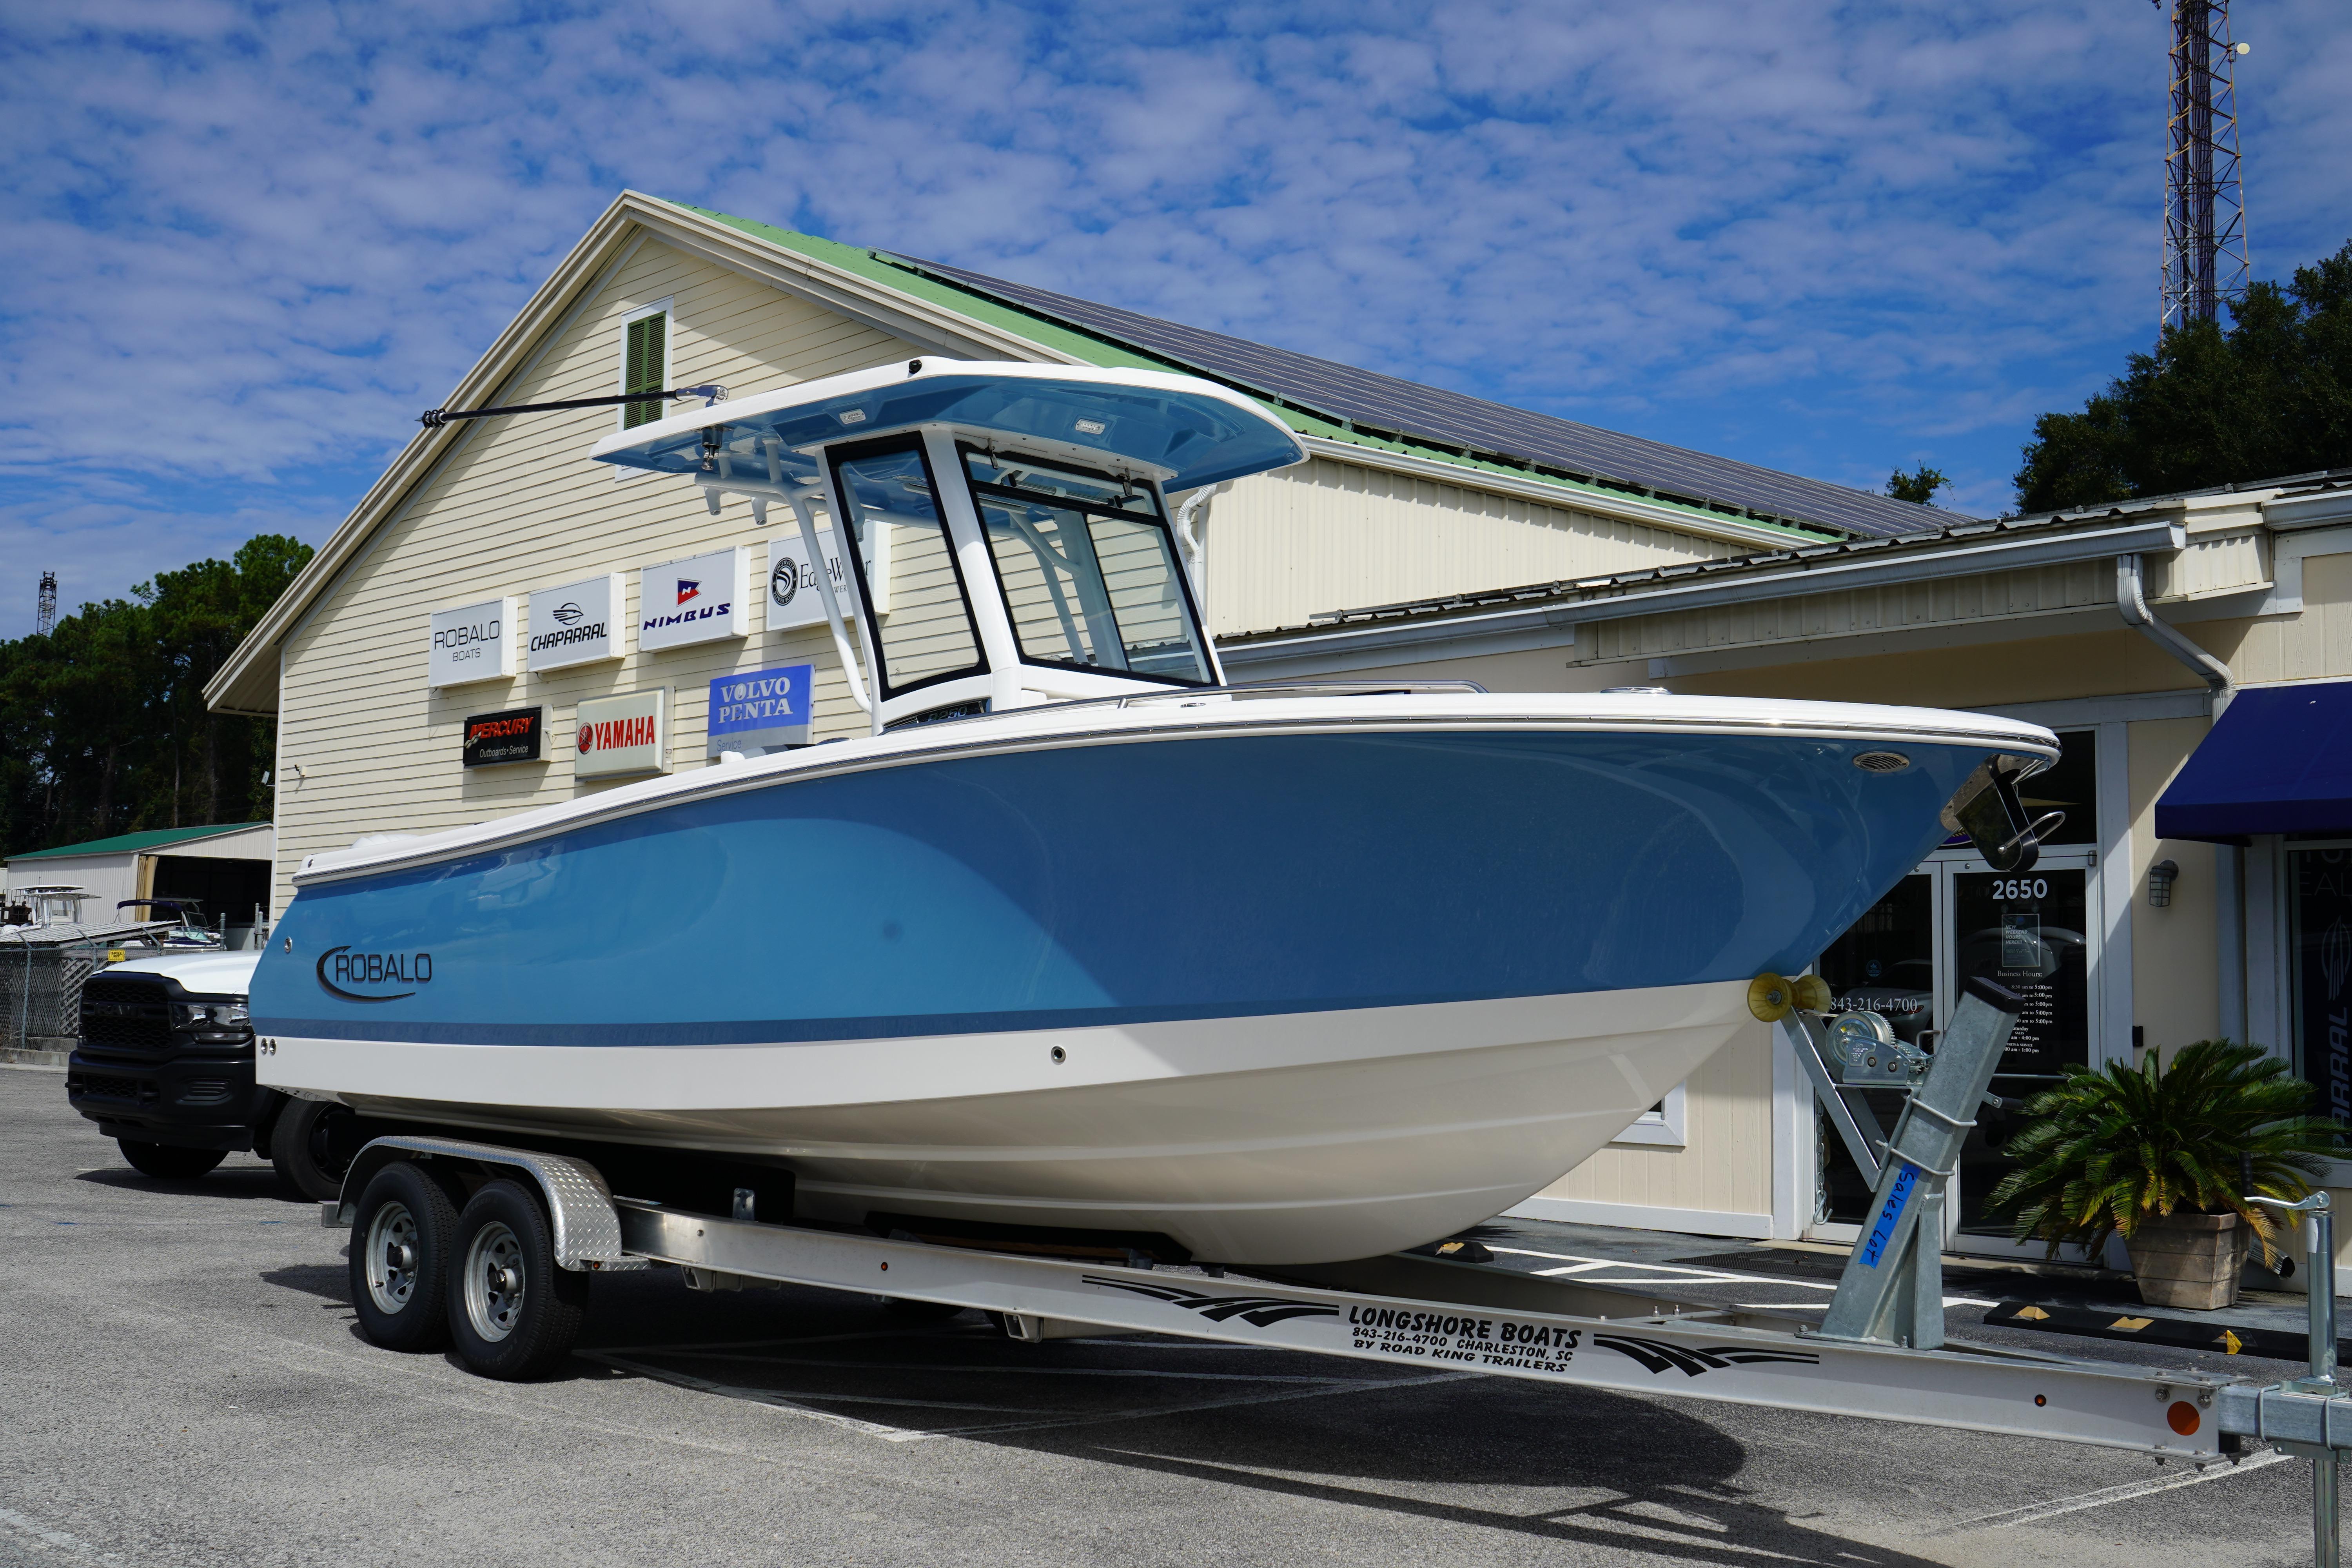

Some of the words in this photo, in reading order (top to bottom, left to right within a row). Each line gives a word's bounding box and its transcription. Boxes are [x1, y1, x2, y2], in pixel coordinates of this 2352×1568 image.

[775, 561, 795, 574] EDGEWATER
[643, 603, 731, 630] NIMBUS
[434, 620, 500, 650] ROBALO
[531, 622, 607, 652] CHAPARRAL
[453, 648, 481, 662] BOATS
[720, 677, 791, 702] VOLVO
[718, 698, 793, 724] PENTA
[469, 717, 534, 740] MERCURY
[595, 716, 655, 750] YAMAHA
[717, 738, 742, 752] Service
[1993, 879, 2048, 899] 2650
[336, 953, 432, 983] ROBALO
[1830, 997, 1918, 1012] 843-216-4700
[1882, 1171, 1915, 1221] Sales
[1349, 1305, 1492, 1340] LONGSHORE
[1500, 1322, 1582, 1348] BOATS
[1352, 1327, 1448, 1347] 843-216-4700
[1457, 1339, 1550, 1361] CHARLESTON,
[1555, 1350, 1573, 1361] SC
[1354, 1339, 1374, 1348] BY
[1380, 1341, 1426, 1355] ROAD
[1432, 1348, 1475, 1361] KING
[1482, 1354, 1567, 1372] TRAILERS
